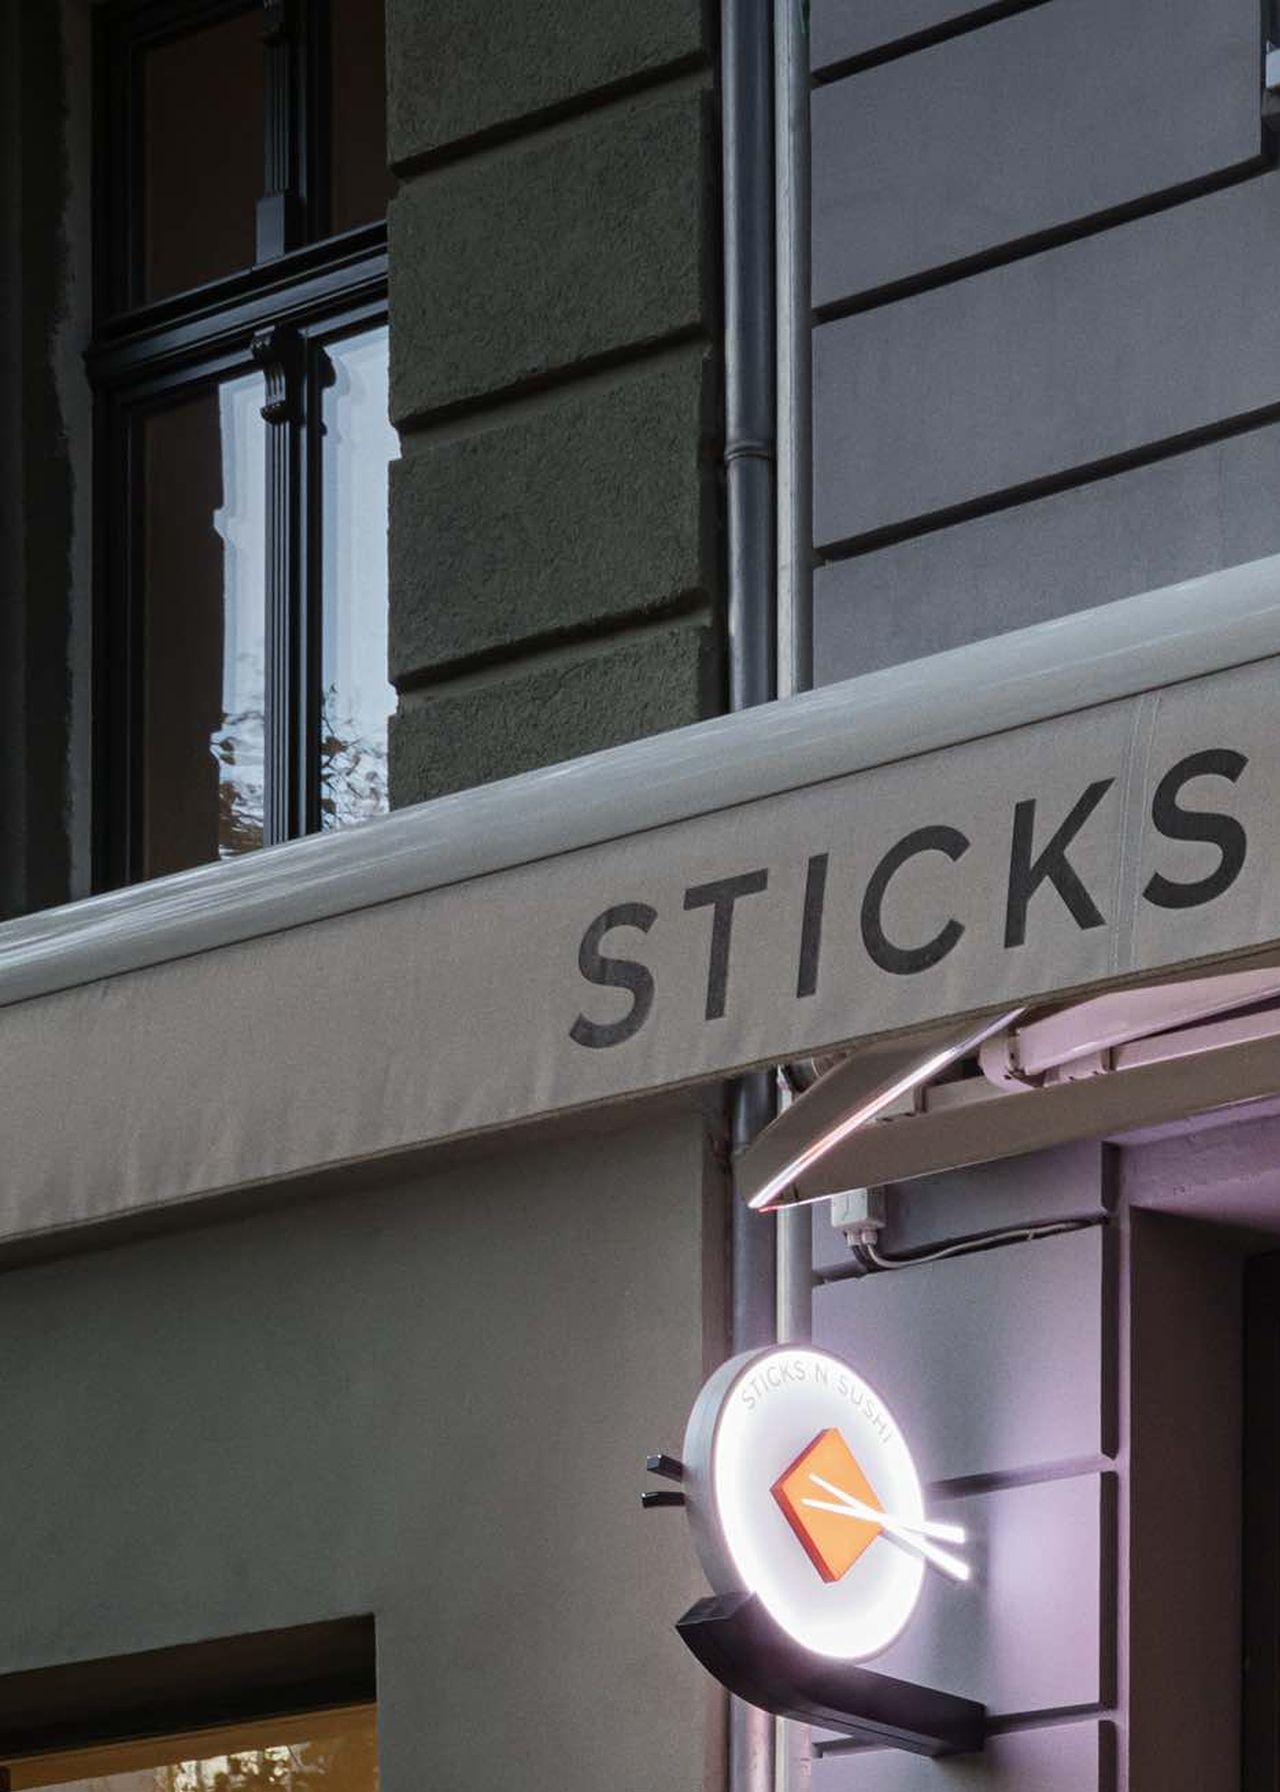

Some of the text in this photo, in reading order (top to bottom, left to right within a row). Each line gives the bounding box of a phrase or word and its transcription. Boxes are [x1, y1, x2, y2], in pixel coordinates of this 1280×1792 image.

[568, 747, 1251, 1050] STICKS
[741, 1359, 893, 1443] STICKS N SUSHI
